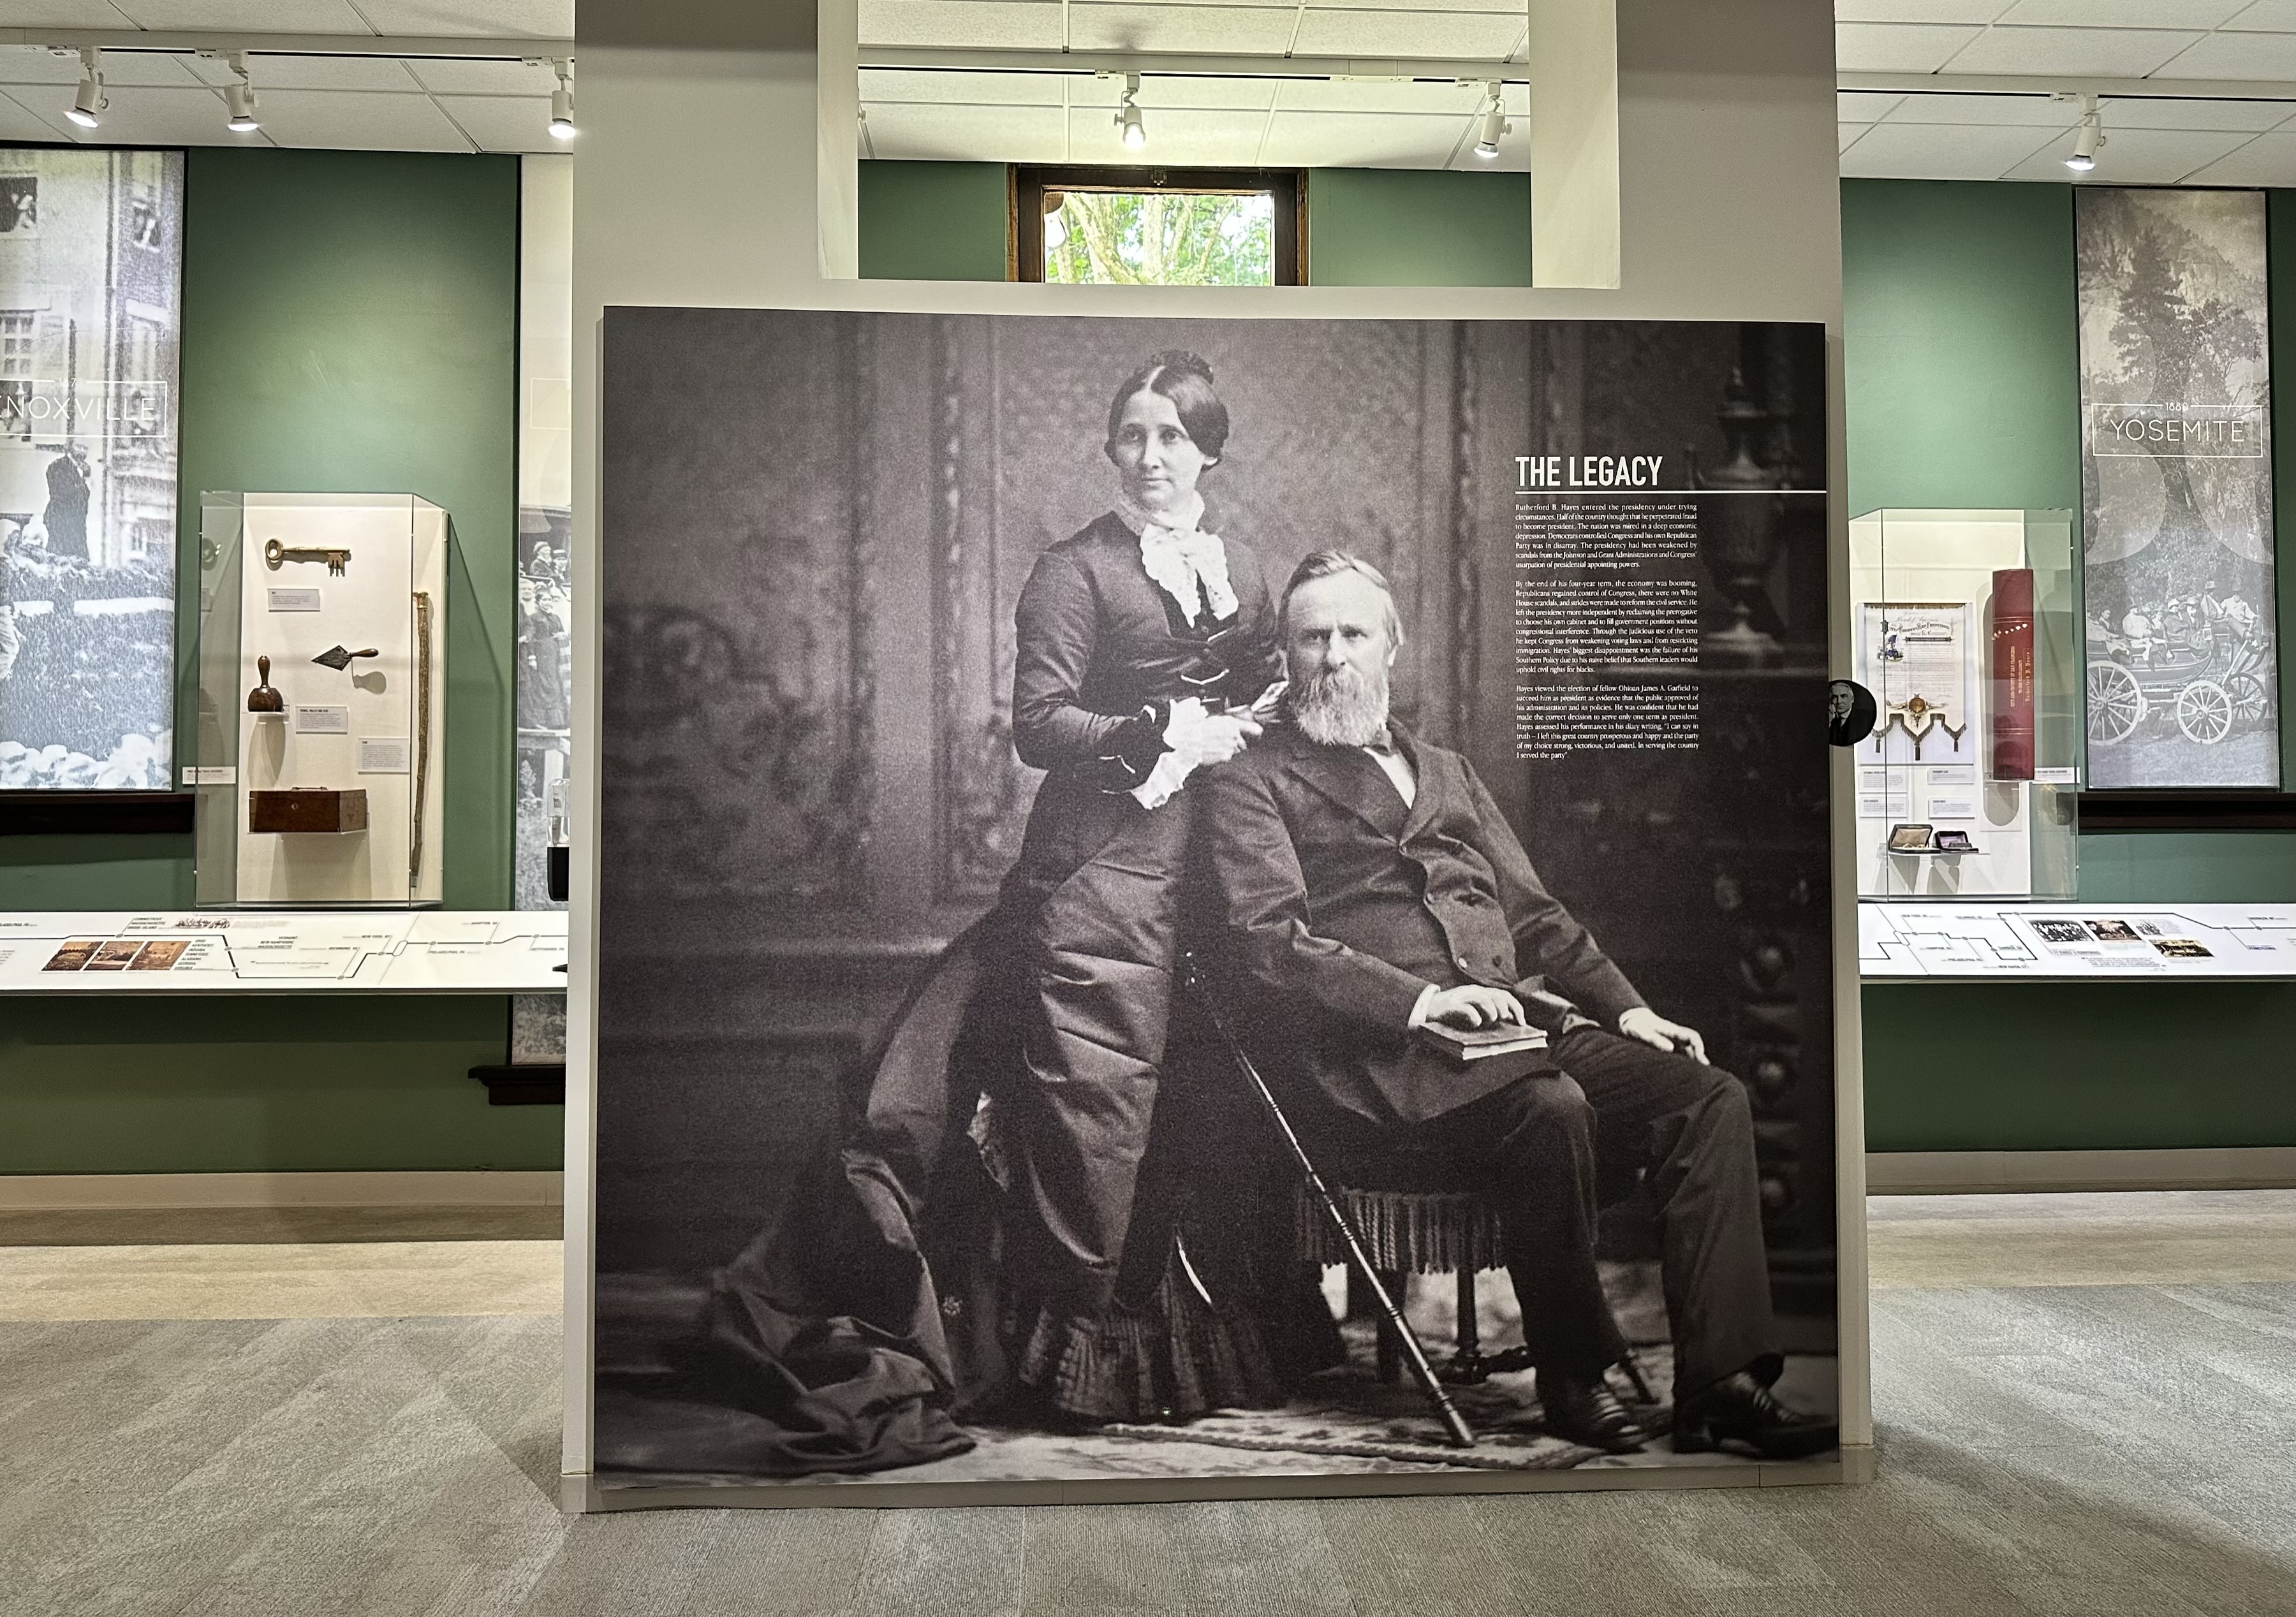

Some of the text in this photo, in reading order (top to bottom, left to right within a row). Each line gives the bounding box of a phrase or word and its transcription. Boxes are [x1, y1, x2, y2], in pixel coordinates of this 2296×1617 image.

[0, 395, 156, 421] NOXVILLE
[2165, 402, 2188, 413] 1880
[2109, 418, 2245, 443] YOSEMITE
[1515, 456, 1663, 487] THE LEGACY
[1561, 504, 1579, 512] Hayes
[1621, 504, 1656, 512] presidency
[1679, 504, 1697, 512] trying
[1584, 513, 1607, 522] country
[1607, 513, 1629, 522] thought
[1649, 513, 1682, 522] perpetrated
[1652, 523, 1668, 531] deep
[1607, 532, 1633, 540] Congress
[1666, 532, 1697, 540] Republican
[1515, 542, 1531, 550] Party
[1594, 542, 1628, 550] presidency
[1563, 551, 1587, 559] Johnson
[1515, 561, 1546, 569] usurpation
[1554, 561, 1587, 569] presidential
[1587, 561, 1617, 569] appointing
[1569, 580, 1596, 588] four-year
[1515, 589, 1551, 597] Republicans
[1551, 589, 1577, 597] regained
[1516, 685, 1534, 693] Hayes
[1640, 685, 1659, 693] James
[1560, 694, 1587, 703] president
[1645, 694, 1663, 703] public
[1664, 694, 1691, 703] approved
